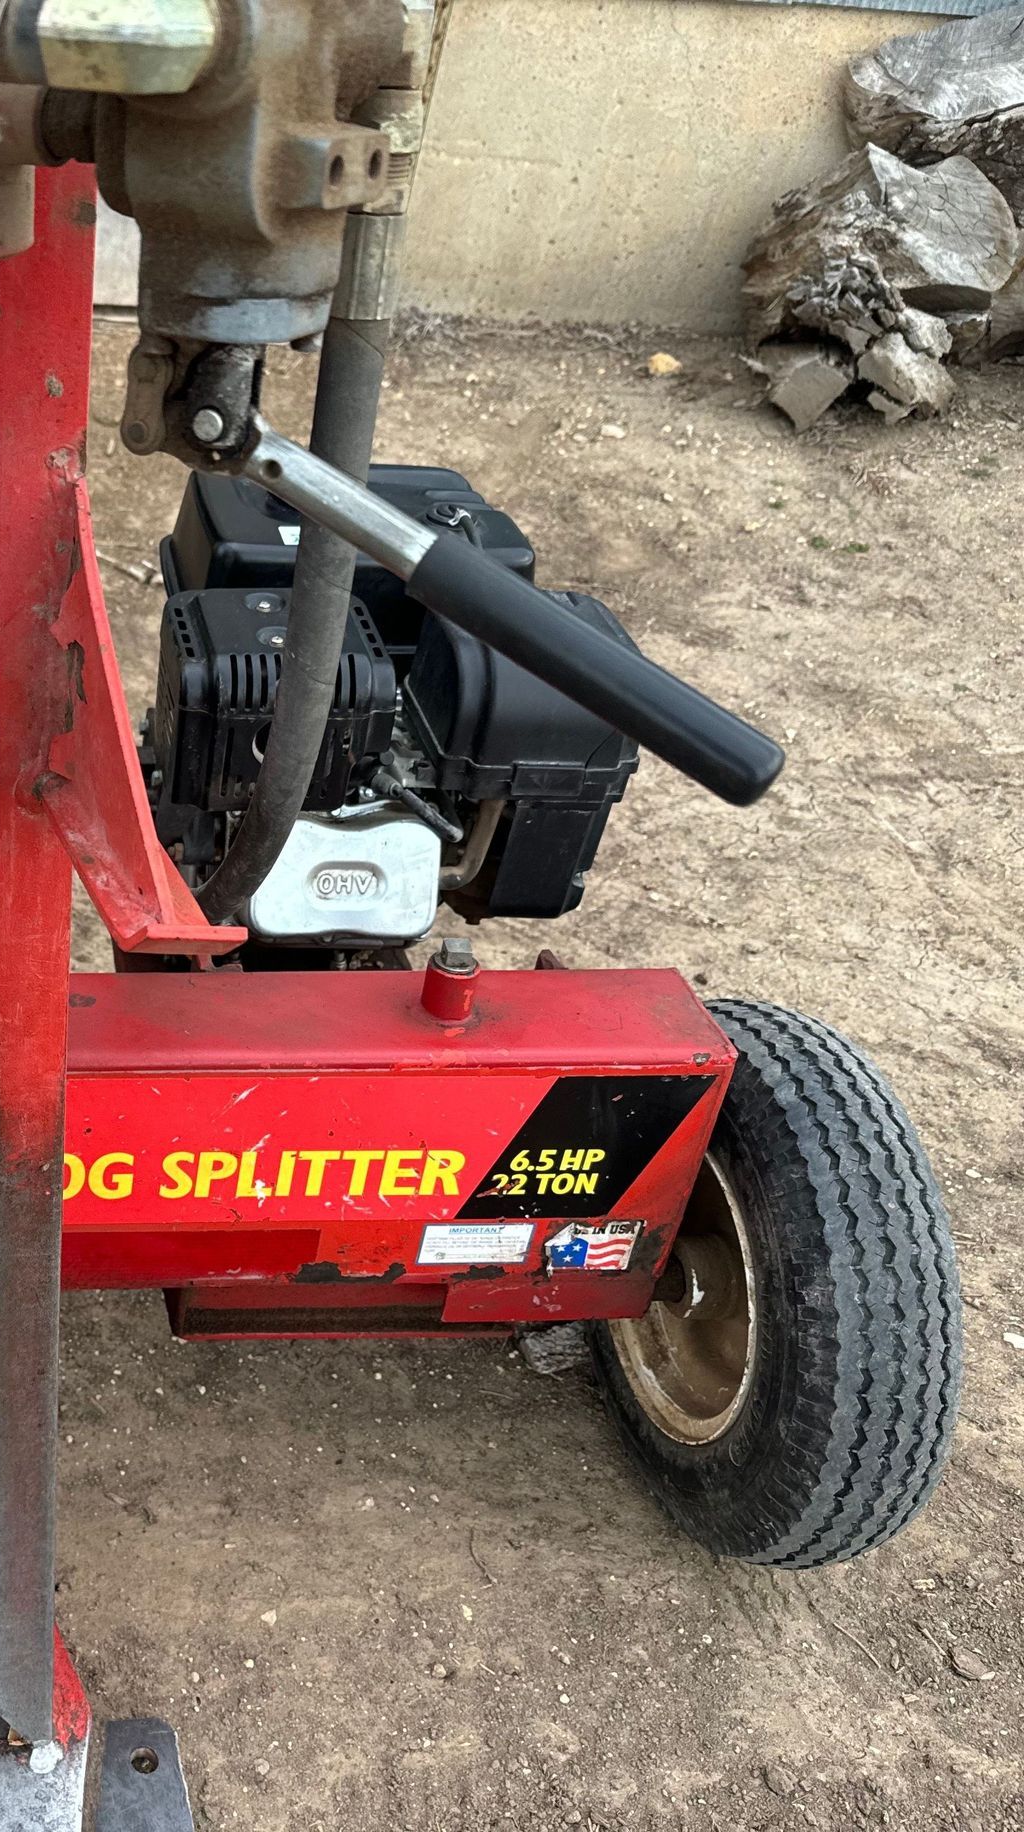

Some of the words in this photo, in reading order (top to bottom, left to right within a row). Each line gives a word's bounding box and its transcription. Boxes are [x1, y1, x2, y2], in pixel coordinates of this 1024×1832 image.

[317, 873, 373, 895] OHV
[509, 1149, 557, 1171] 6.5
[559, 1149, 606, 1171] HP
[159, 1150, 466, 1199] SPLITTER
[490, 1173, 528, 1195] 22
[536, 1173, 599, 1195] TON
[449, 1226, 504, 1234] IMPORTANT
